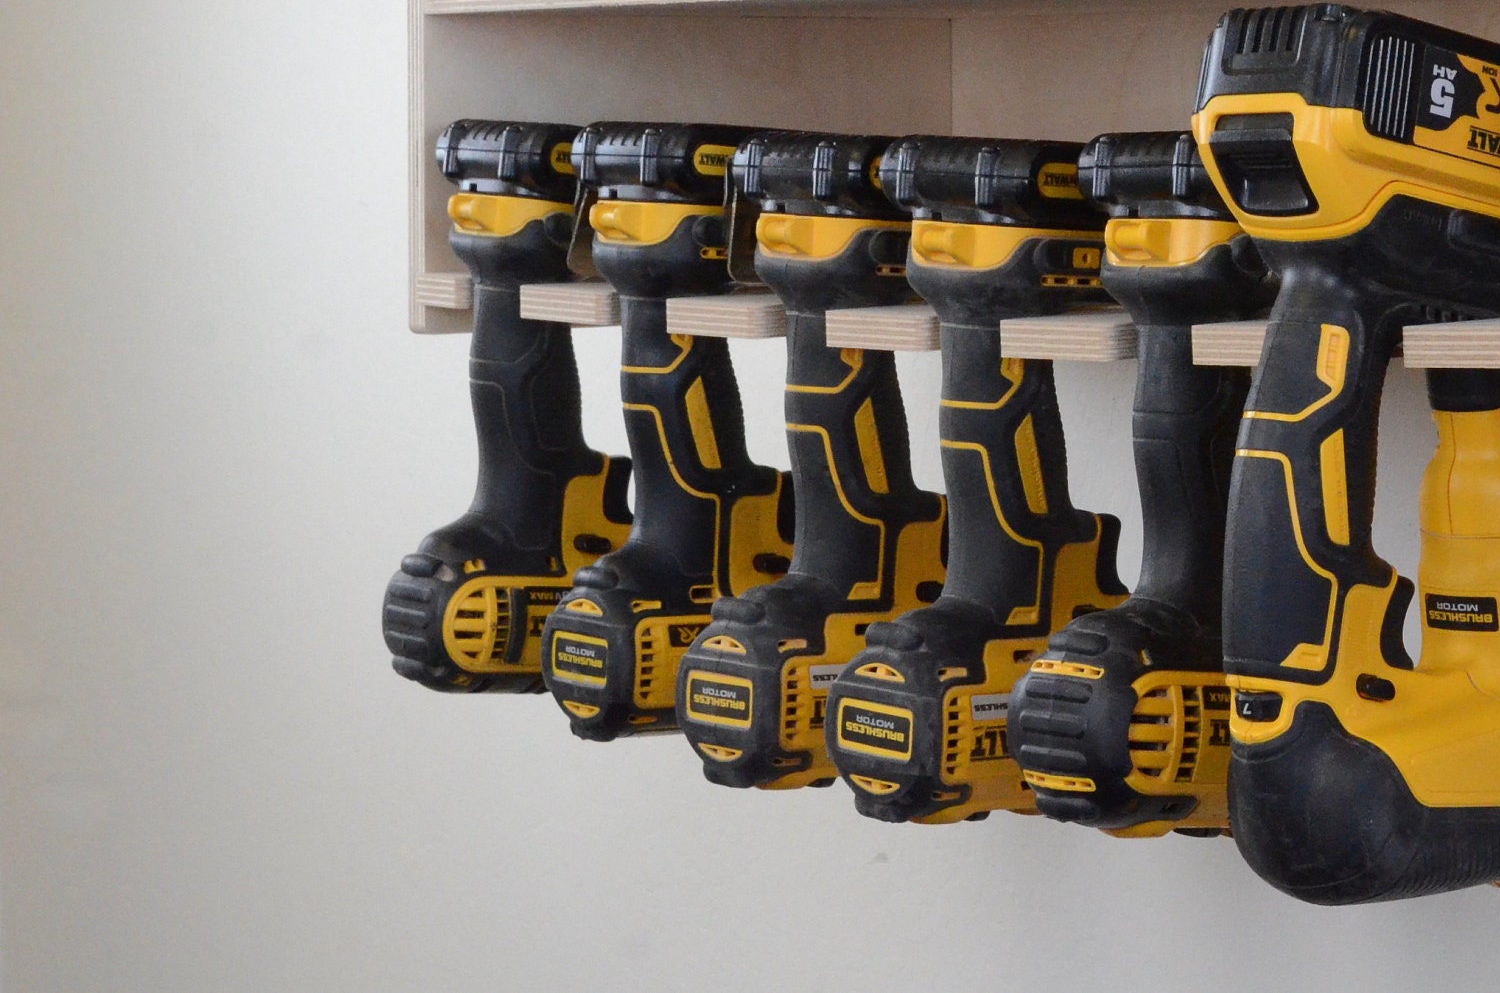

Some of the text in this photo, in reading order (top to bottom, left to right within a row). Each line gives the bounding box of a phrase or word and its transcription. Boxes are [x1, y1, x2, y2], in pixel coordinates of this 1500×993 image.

[1482, 65, 1499, 77] ION
[1430, 78, 1455, 118] 5
[699, 152, 728, 166] WALT
[1436, 601, 1479, 612] MOTOR
[1429, 610, 1493, 623] BRUSHLESS
[565, 646, 595, 657] MOTOR
[558, 652, 603, 668] BRUSHLESS
[702, 687, 736, 699] MOTOR
[693, 694, 746, 710] BRUSHLESS
[974, 702, 1008, 712] SHLESS
[856, 715, 895, 729] MOTOR
[845, 721, 905, 743] BRUSHLESS
